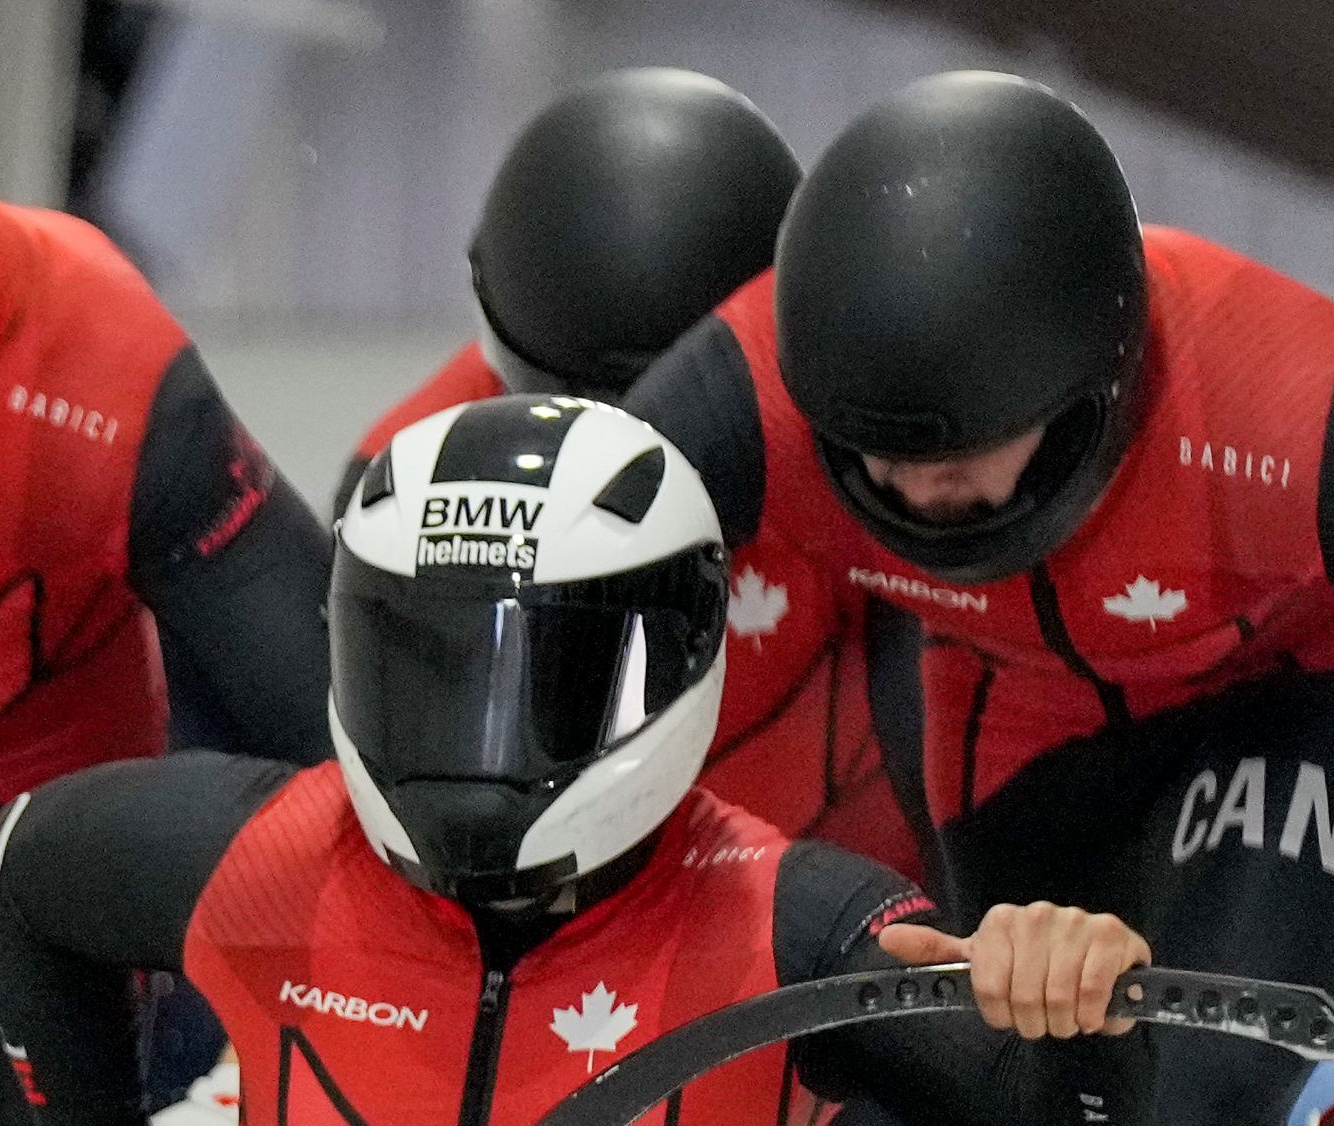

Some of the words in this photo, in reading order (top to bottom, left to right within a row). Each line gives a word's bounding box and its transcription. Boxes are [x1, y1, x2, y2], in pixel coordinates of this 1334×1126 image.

[1179, 436, 1291, 490] BABICI
[421, 497, 544, 531] BMW
[418, 534, 536, 570] helmets
[848, 566, 988, 614] KARBON
[279, 978, 430, 1033] KARBON
